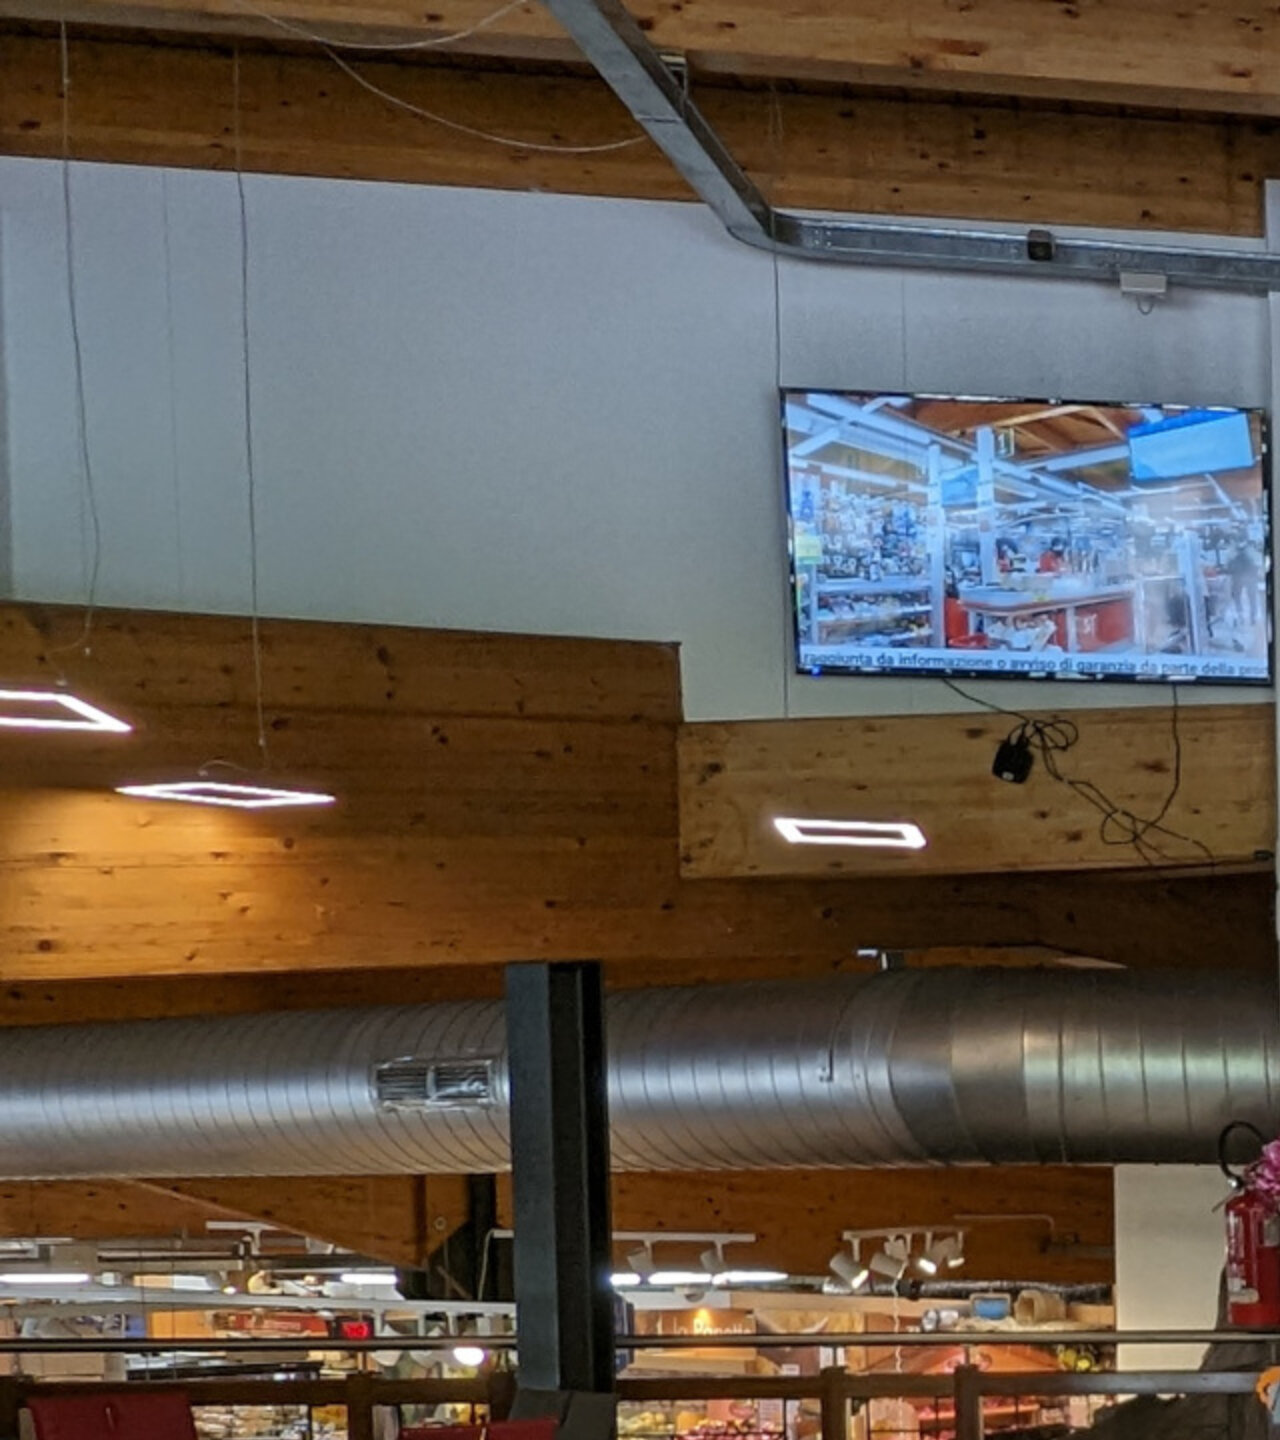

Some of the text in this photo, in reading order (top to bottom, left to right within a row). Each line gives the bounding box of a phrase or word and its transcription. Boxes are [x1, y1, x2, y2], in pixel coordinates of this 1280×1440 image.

[877, 652, 894, 666] da
[898, 652, 994, 669] informazione
[1010, 658, 1056, 671] avviso
[1059, 657, 1074, 671] di
[1078, 660, 1136, 675] garanzia
[1201, 661, 1235, 674] della
